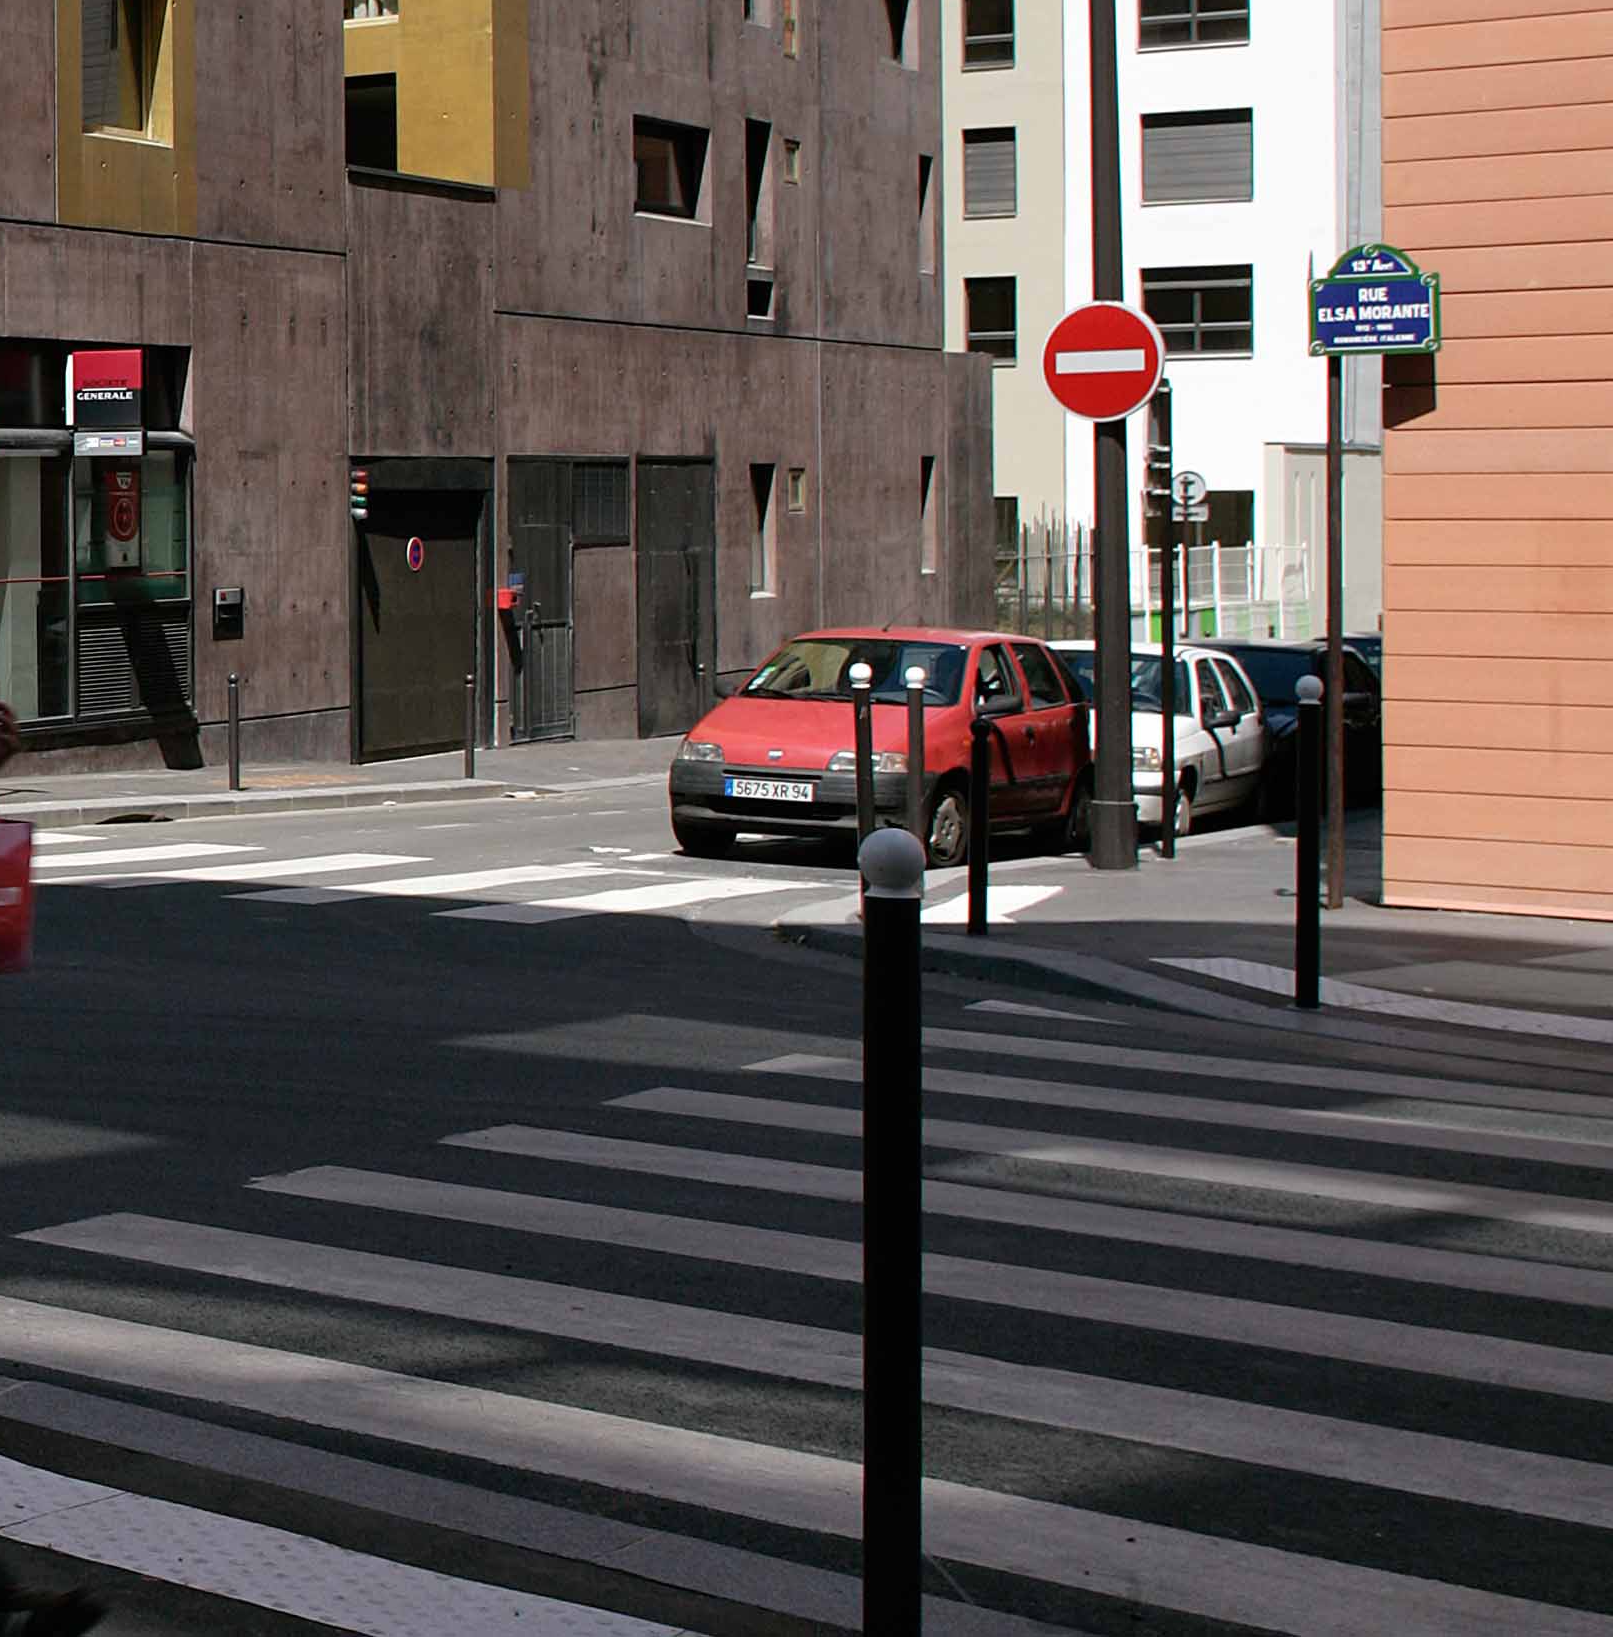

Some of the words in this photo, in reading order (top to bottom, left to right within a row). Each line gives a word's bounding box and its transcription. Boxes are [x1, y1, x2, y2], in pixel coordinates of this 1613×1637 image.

[1358, 287, 1388, 303] RUE
[1318, 307, 1356, 322] ELSA
[1359, 303, 1430, 321] MORANTE
[77, 391, 133, 400] GENERALE
[736, 781, 769, 797] 5675
[772, 784, 789, 798] XR
[792, 785, 808, 799] 94
